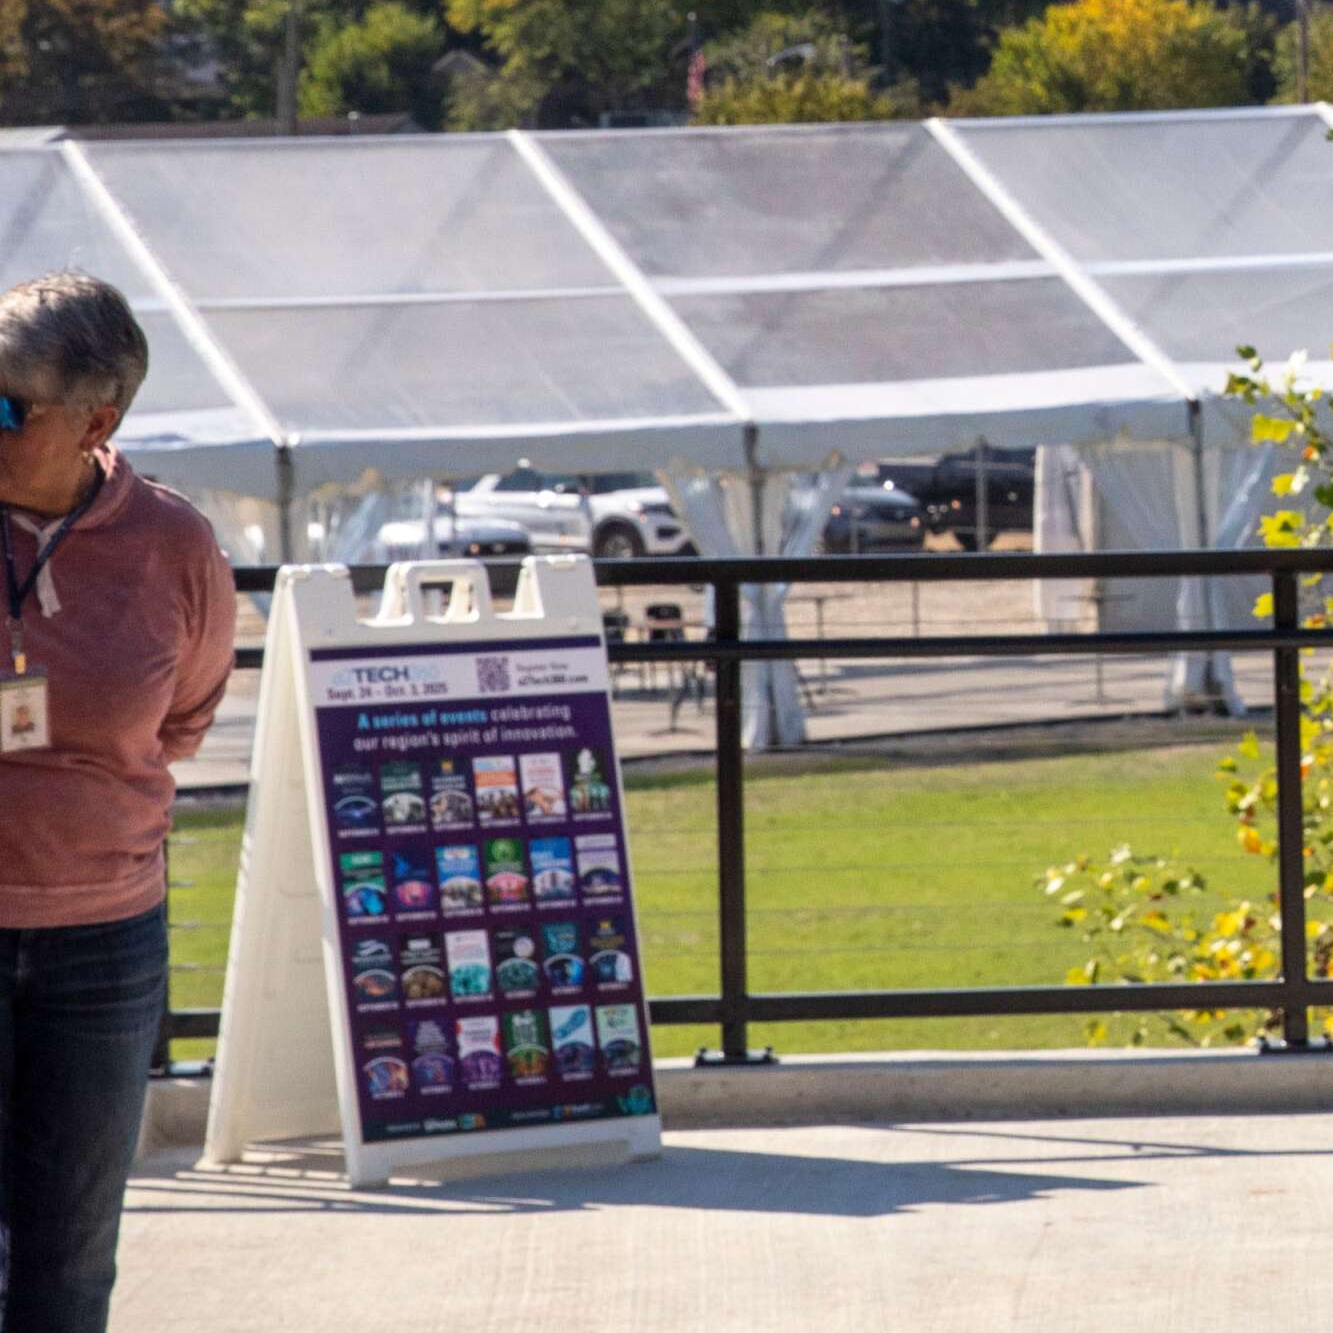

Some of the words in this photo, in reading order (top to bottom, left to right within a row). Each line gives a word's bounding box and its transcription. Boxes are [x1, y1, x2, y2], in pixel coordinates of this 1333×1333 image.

[358, 713, 369, 729] A
[372, 712, 418, 728] series
[421, 710, 437, 727] of
[440, 708, 488, 724] events
[491, 704, 571, 721] celebrating
[354, 737, 378, 751] our
[442, 729, 480, 748] spirit
[484, 726, 499, 743] of
